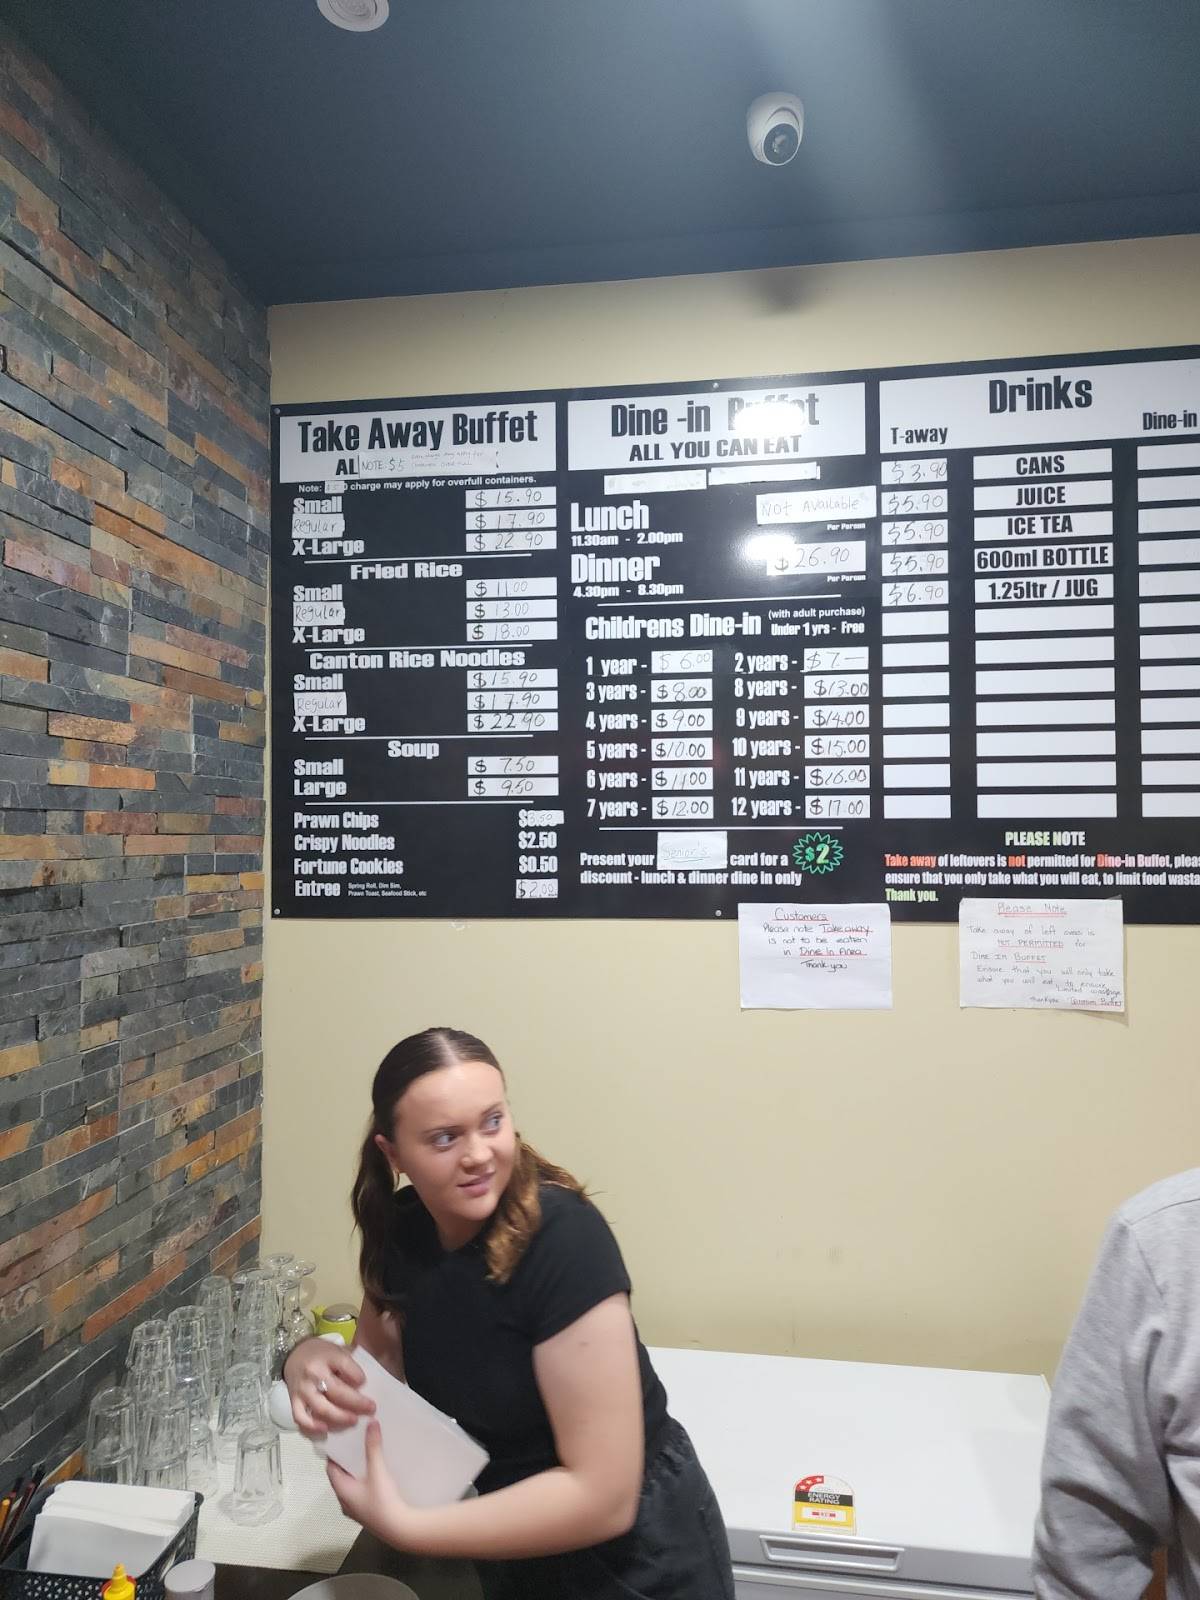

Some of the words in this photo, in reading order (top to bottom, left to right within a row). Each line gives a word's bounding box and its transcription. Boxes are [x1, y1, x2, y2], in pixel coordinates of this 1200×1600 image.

[988, 375, 1092, 414] Drinks
[611, 404, 668, 437] Dine
[1142, 410, 1198, 431] Dine-in
[298, 421, 359, 452] Take
[368, 418, 444, 451] Away
[452, 410, 538, 445] Buffet
[890, 427, 948, 445] T-away
[630, 444, 664, 462] ALL
[671, 440, 710, 459] YOU
[717, 439, 758, 457] CAN
[764, 435, 802, 454] EAT
[1016, 455, 1065, 475] CANS
[350, 481, 380, 491] charge
[384, 481, 402, 490] may
[405, 480, 429, 489] apply
[432, 478, 445, 486] for
[448, 477, 482, 486] overfull
[485, 476, 537, 485] containers.
[294, 496, 342, 514] Small
[1016, 486, 1066, 506] JUICE
[570, 500, 649, 532] Lunch
[294, 519, 337, 534] Regular
[1007, 517, 1036, 536] ICE
[1041, 515, 1073, 533] TEA
[292, 538, 365, 556] X-Large
[572, 534, 618, 546] 11.30am
[637, 532, 683, 545] 2.00pm
[977, 550, 1037, 569] 600ml
[1043, 546, 1108, 566] BOTTLE
[350, 563, 408, 580] Fried
[415, 562, 463, 578] Rice
[571, 553, 660, 583] Dinner
[294, 584, 342, 601] Small
[573, 586, 620, 598] 4.30pm
[638, 584, 684, 596] 8.30pm
[988, 580, 1047, 600] 1.25ltr
[1065, 579, 1098, 597] JUG
[296, 605, 341, 622] Regular
[769, 609, 791, 620] (with
[793, 608, 816, 618] adult
[819, 606, 865, 619] purchase)
[586, 616, 684, 640] Childrens
[690, 612, 762, 636] Dine-in
[771, 624, 800, 636] Under
[803, 622, 810, 636] 1
[812, 624, 830, 637] yrs
[841, 621, 865, 634] Free
[292, 626, 365, 645] X-Large
[310, 652, 383, 670] Canton
[389, 651, 434, 668] Rice
[441, 649, 526, 668] Noodles
[601, 658, 637, 677] year
[734, 652, 744, 672] 2
[748, 653, 788, 674] years
[294, 674, 344, 691] Small
[586, 682, 595, 700] 3
[599, 683, 638, 702] years
[297, 697, 343, 714] Regular
[292, 716, 366, 734] X-Large
[586, 712, 595, 729] 4
[599, 712, 638, 732] years
[388, 741, 440, 759] Soup
[732, 738, 747, 756] 10
[750, 738, 791, 759] years
[294, 759, 344, 776] Small
[734, 768, 746, 786] 11
[749, 768, 790, 789] years
[294, 780, 347, 798] Large
[587, 799, 596, 817] 7
[599, 800, 638, 820] years
[732, 798, 747, 816] 12
[750, 798, 792, 819] years
[294, 812, 340, 829] Prawn
[343, 812, 380, 830] Chips
[294, 834, 339, 852] Crispy
[342, 834, 395, 851] Noodles
[518, 831, 557, 849] $2.50
[1005, 831, 1050, 846] PLEASE
[1053, 831, 1086, 846] NOTE
[580, 853, 626, 866] Present
[628, 855, 654, 868] your
[730, 852, 758, 866] card
[760, 852, 778, 866] for
[780, 855, 788, 866] a
[806, 844, 830, 865] $2
[885, 854, 909, 867] Take
[910, 855, 936, 869] away
[938, 854, 948, 867] of
[950, 854, 996, 867] leftovers
[997, 854, 1007, 867] is
[1009, 855, 1026, 867] not
[1027, 854, 1079, 869] permitted
[1081, 854, 1096, 867] for
[1097, 854, 1135, 867] Dine-in
[1137, 854, 1172, 868] Buffet,
[294, 858, 347, 875] Fortune
[350, 858, 404, 875] Cookies
[518, 854, 558, 874] $0.50
[580, 871, 633, 885] discount
[641, 871, 675, 885] lunch
[689, 871, 728, 885] dinner
[731, 871, 759, 885] dine
[761, 871, 773, 885] in
[775, 871, 802, 886] only
[885, 874, 921, 885] ensure
[922, 872, 943, 885] that
[945, 874, 963, 886] you
[965, 872, 986, 886] only
[988, 872, 1010, 885] take
[1012, 872, 1038, 885] what
[1040, 874, 1059, 886] you
[1061, 872, 1079, 885] will
[1081, 873, 1101, 886] eat,
[1103, 872, 1114, 885] to
[1115, 872, 1141, 885] limit
[1142, 872, 1166, 885] food
[295, 880, 341, 897] Entree
[886, 888, 916, 901] Thank
[918, 890, 938, 903] you.
[774, 907, 828, 921] Customers
[763, 922, 789, 933] Please
[800, 947, 823, 956] Dine
[801, 960, 828, 969] Thank
[808, 1492, 841, 1500] ENERGY
